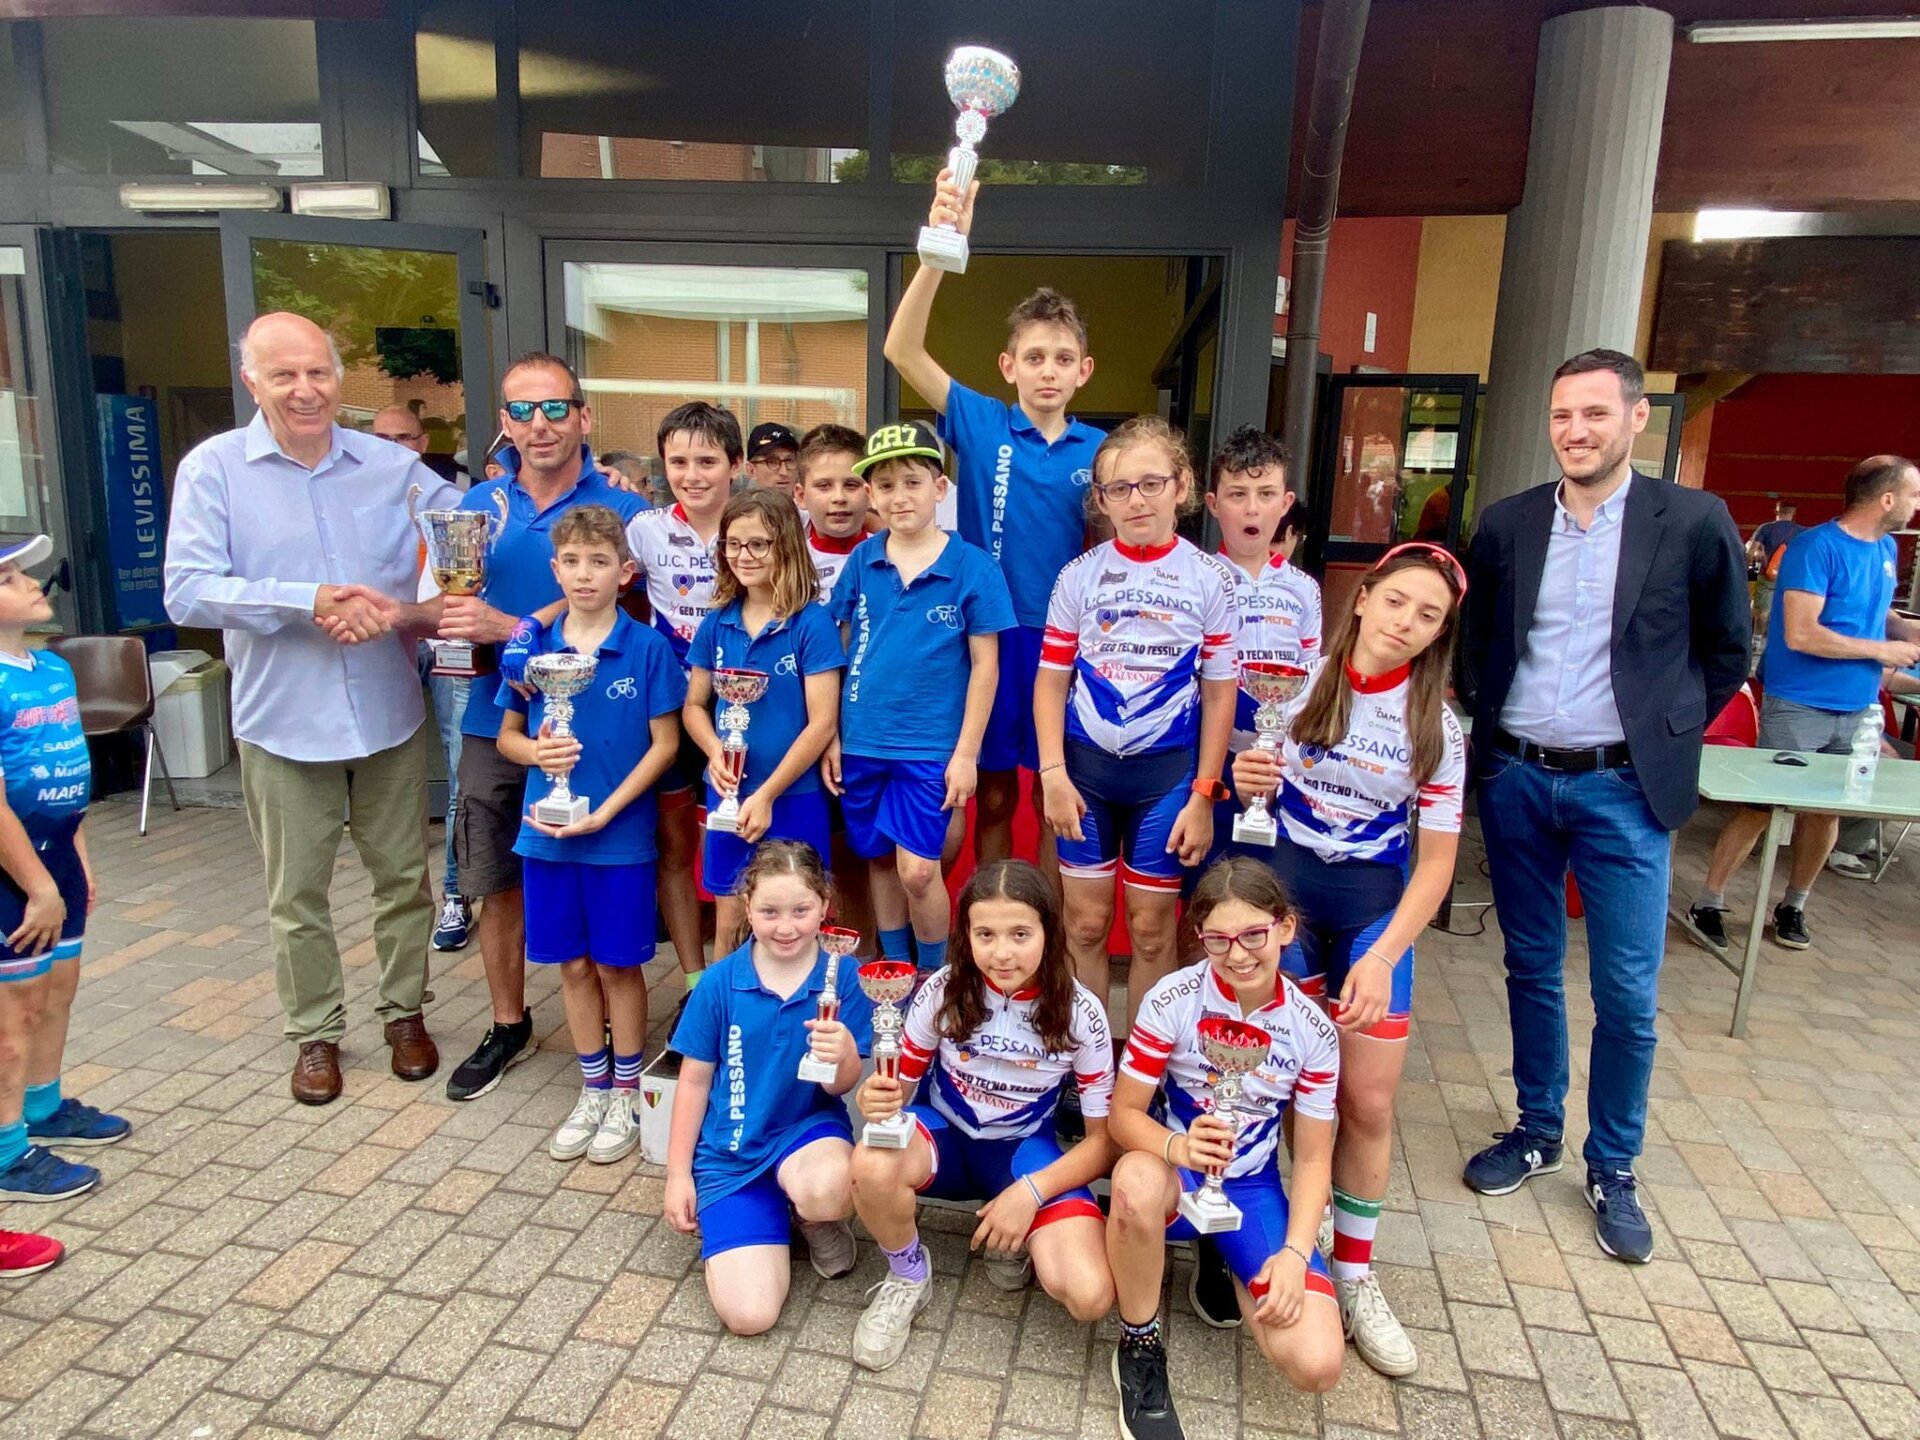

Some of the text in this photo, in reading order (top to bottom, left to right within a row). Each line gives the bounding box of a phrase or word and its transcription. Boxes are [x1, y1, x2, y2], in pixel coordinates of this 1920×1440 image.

[127, 406, 157, 558] LEVISSIMA
[992, 444, 1013, 533] PESSANO
[657, 554, 716, 569] U.C. PES
[696, 607, 712, 617] TEC
[1115, 587, 1193, 612] PESSANO
[850, 593, 870, 676] PESSANO
[1147, 645, 1183, 657] TESSILE
[1246, 650, 1274, 660] TECNO
[1274, 649, 1297, 662] TESSIL
[1348, 735, 1410, 763] SSANO
[1320, 780, 1351, 797] TECNO
[728, 1024, 746, 1120] PESSANO
